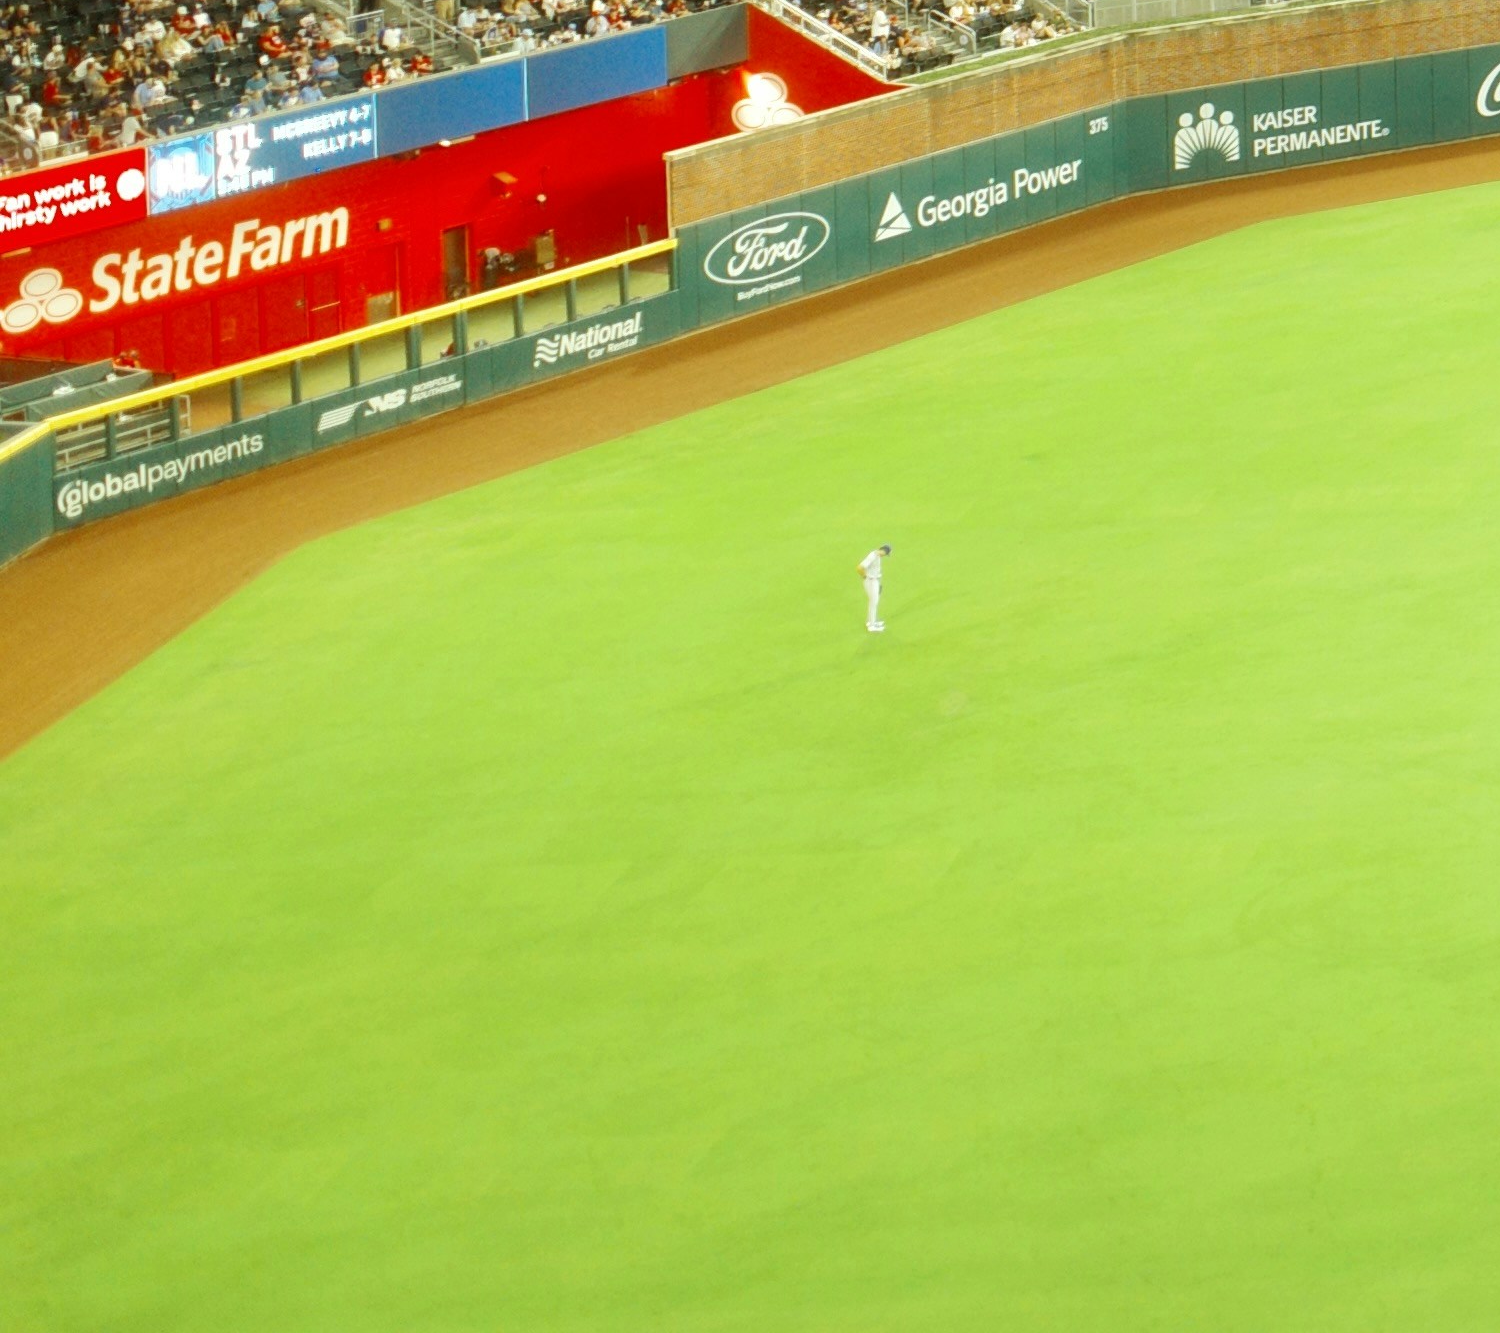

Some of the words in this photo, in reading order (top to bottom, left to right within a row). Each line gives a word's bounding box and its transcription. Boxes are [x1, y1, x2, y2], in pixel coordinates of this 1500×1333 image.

[1089, 116, 1108, 135] 375
[1253, 105, 1317, 132] KAISER
[216, 123, 262, 156] STL
[303, 134, 347, 158] KELLY
[34, 178, 86, 204] work
[89, 174, 106, 192] is
[917, 178, 1007, 226] Georgia
[1014, 159, 1082, 198] Power
[60, 190, 111, 217] work
[727, 222, 809, 277] Ford
[561, 311, 643, 357] National
[588, 347, 604, 359] Car
[608, 336, 638, 353] Rental
[410, 381, 462, 402] SOUTHERN
[411, 374, 457, 394] NORFOLK
[57, 432, 264, 518] globalpayments
